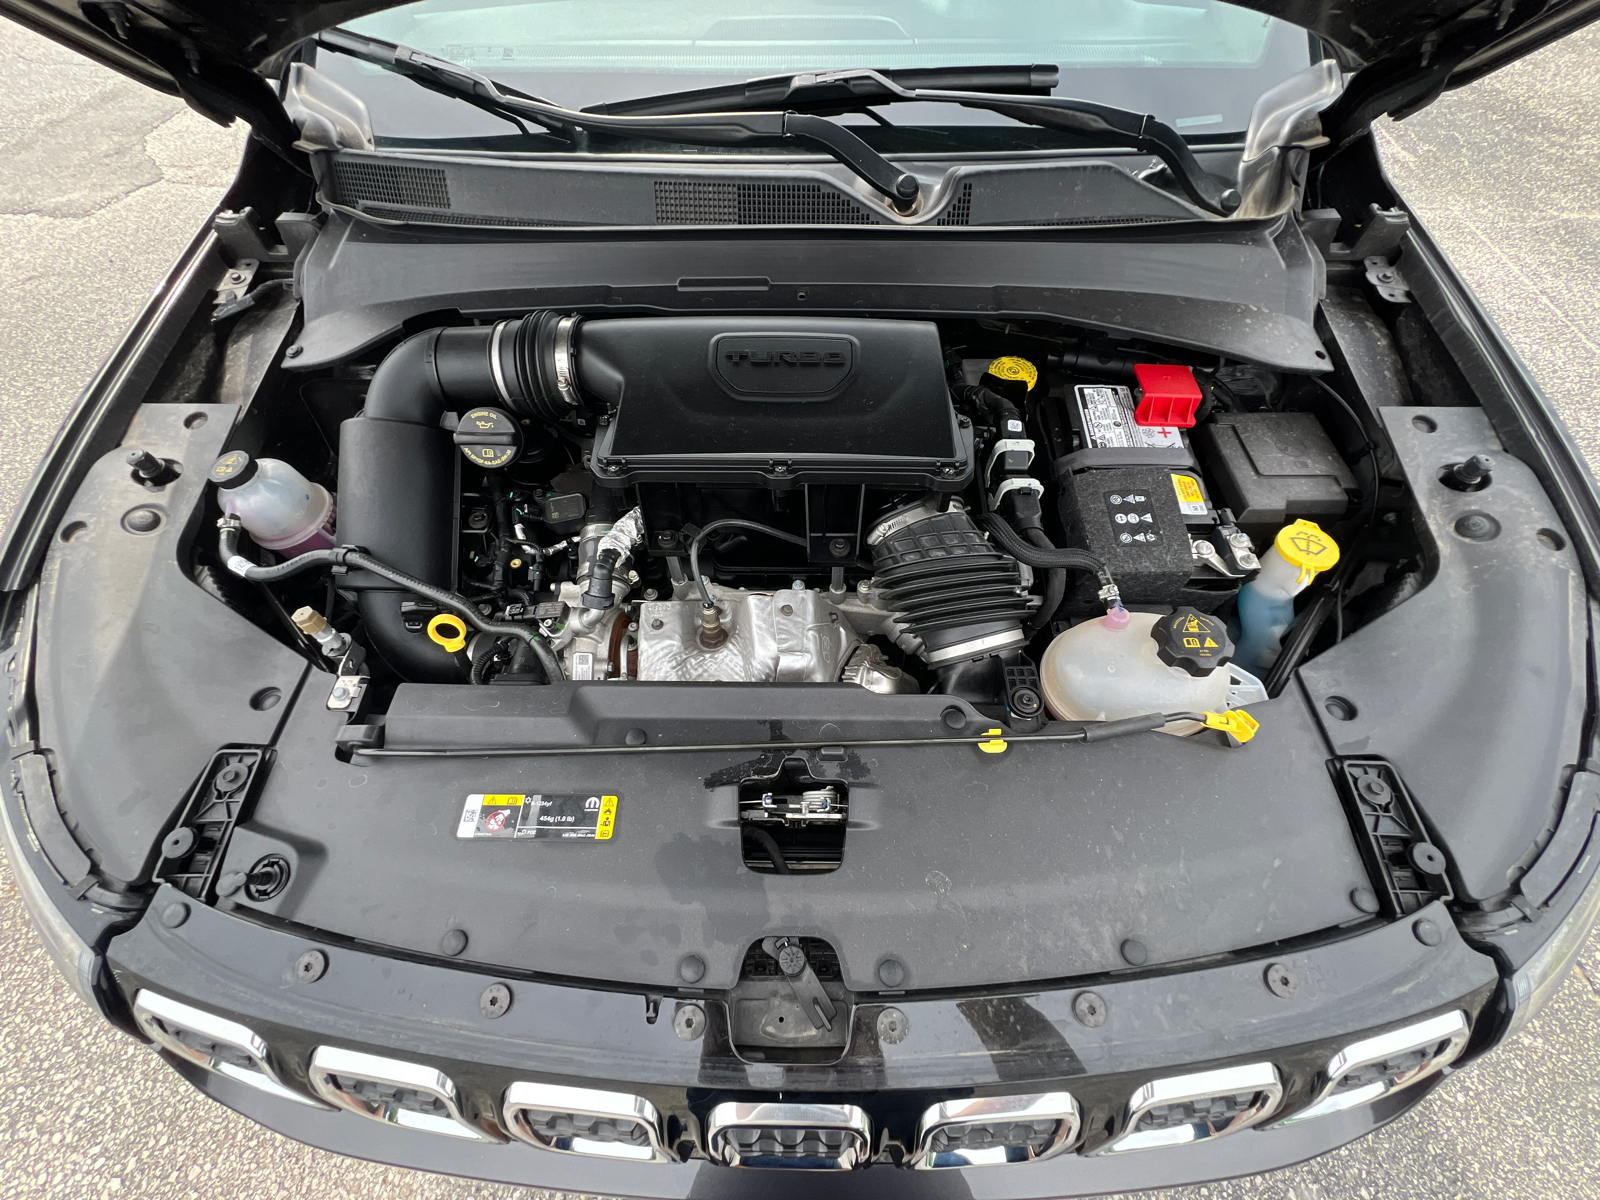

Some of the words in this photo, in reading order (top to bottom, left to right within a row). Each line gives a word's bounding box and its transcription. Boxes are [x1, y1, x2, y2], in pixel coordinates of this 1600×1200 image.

[725, 349, 846, 366] TURBO
[470, 411, 489, 419] ENGINE
[539, 815, 555, 823] 454g
[555, 815, 567, 823] (1.0
[567, 815, 576, 823] lb)
